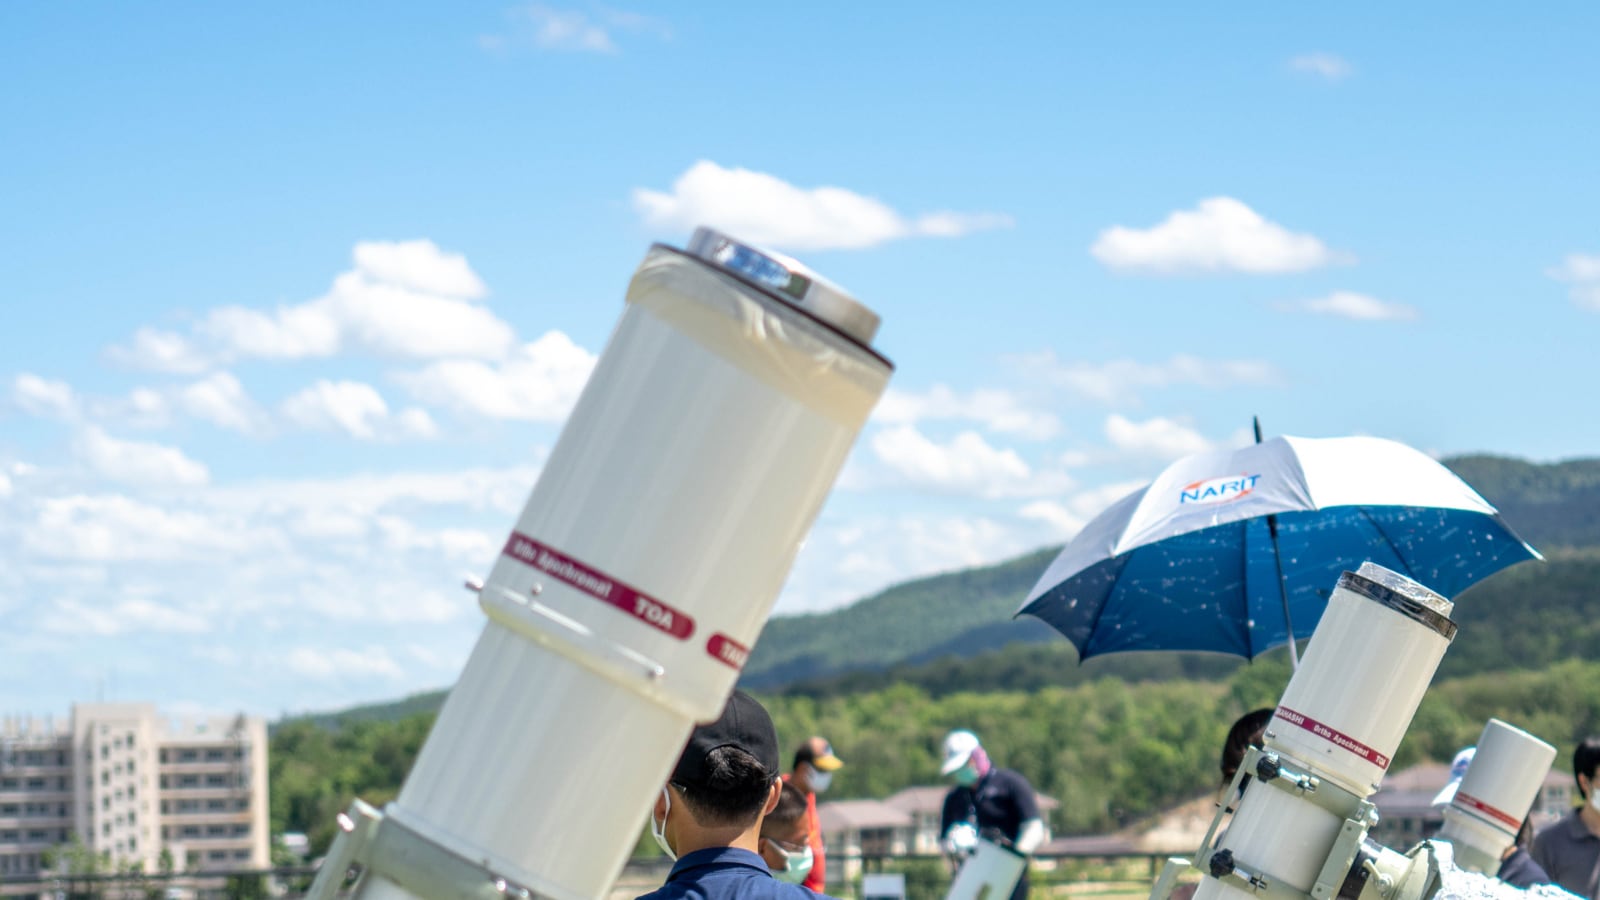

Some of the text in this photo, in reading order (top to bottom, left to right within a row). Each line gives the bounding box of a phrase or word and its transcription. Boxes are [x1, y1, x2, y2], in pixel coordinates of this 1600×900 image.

[1180, 472, 1262, 503] NARIT
[634, 597, 674, 630] TOA
[1313, 724, 1332, 738] Ortho
